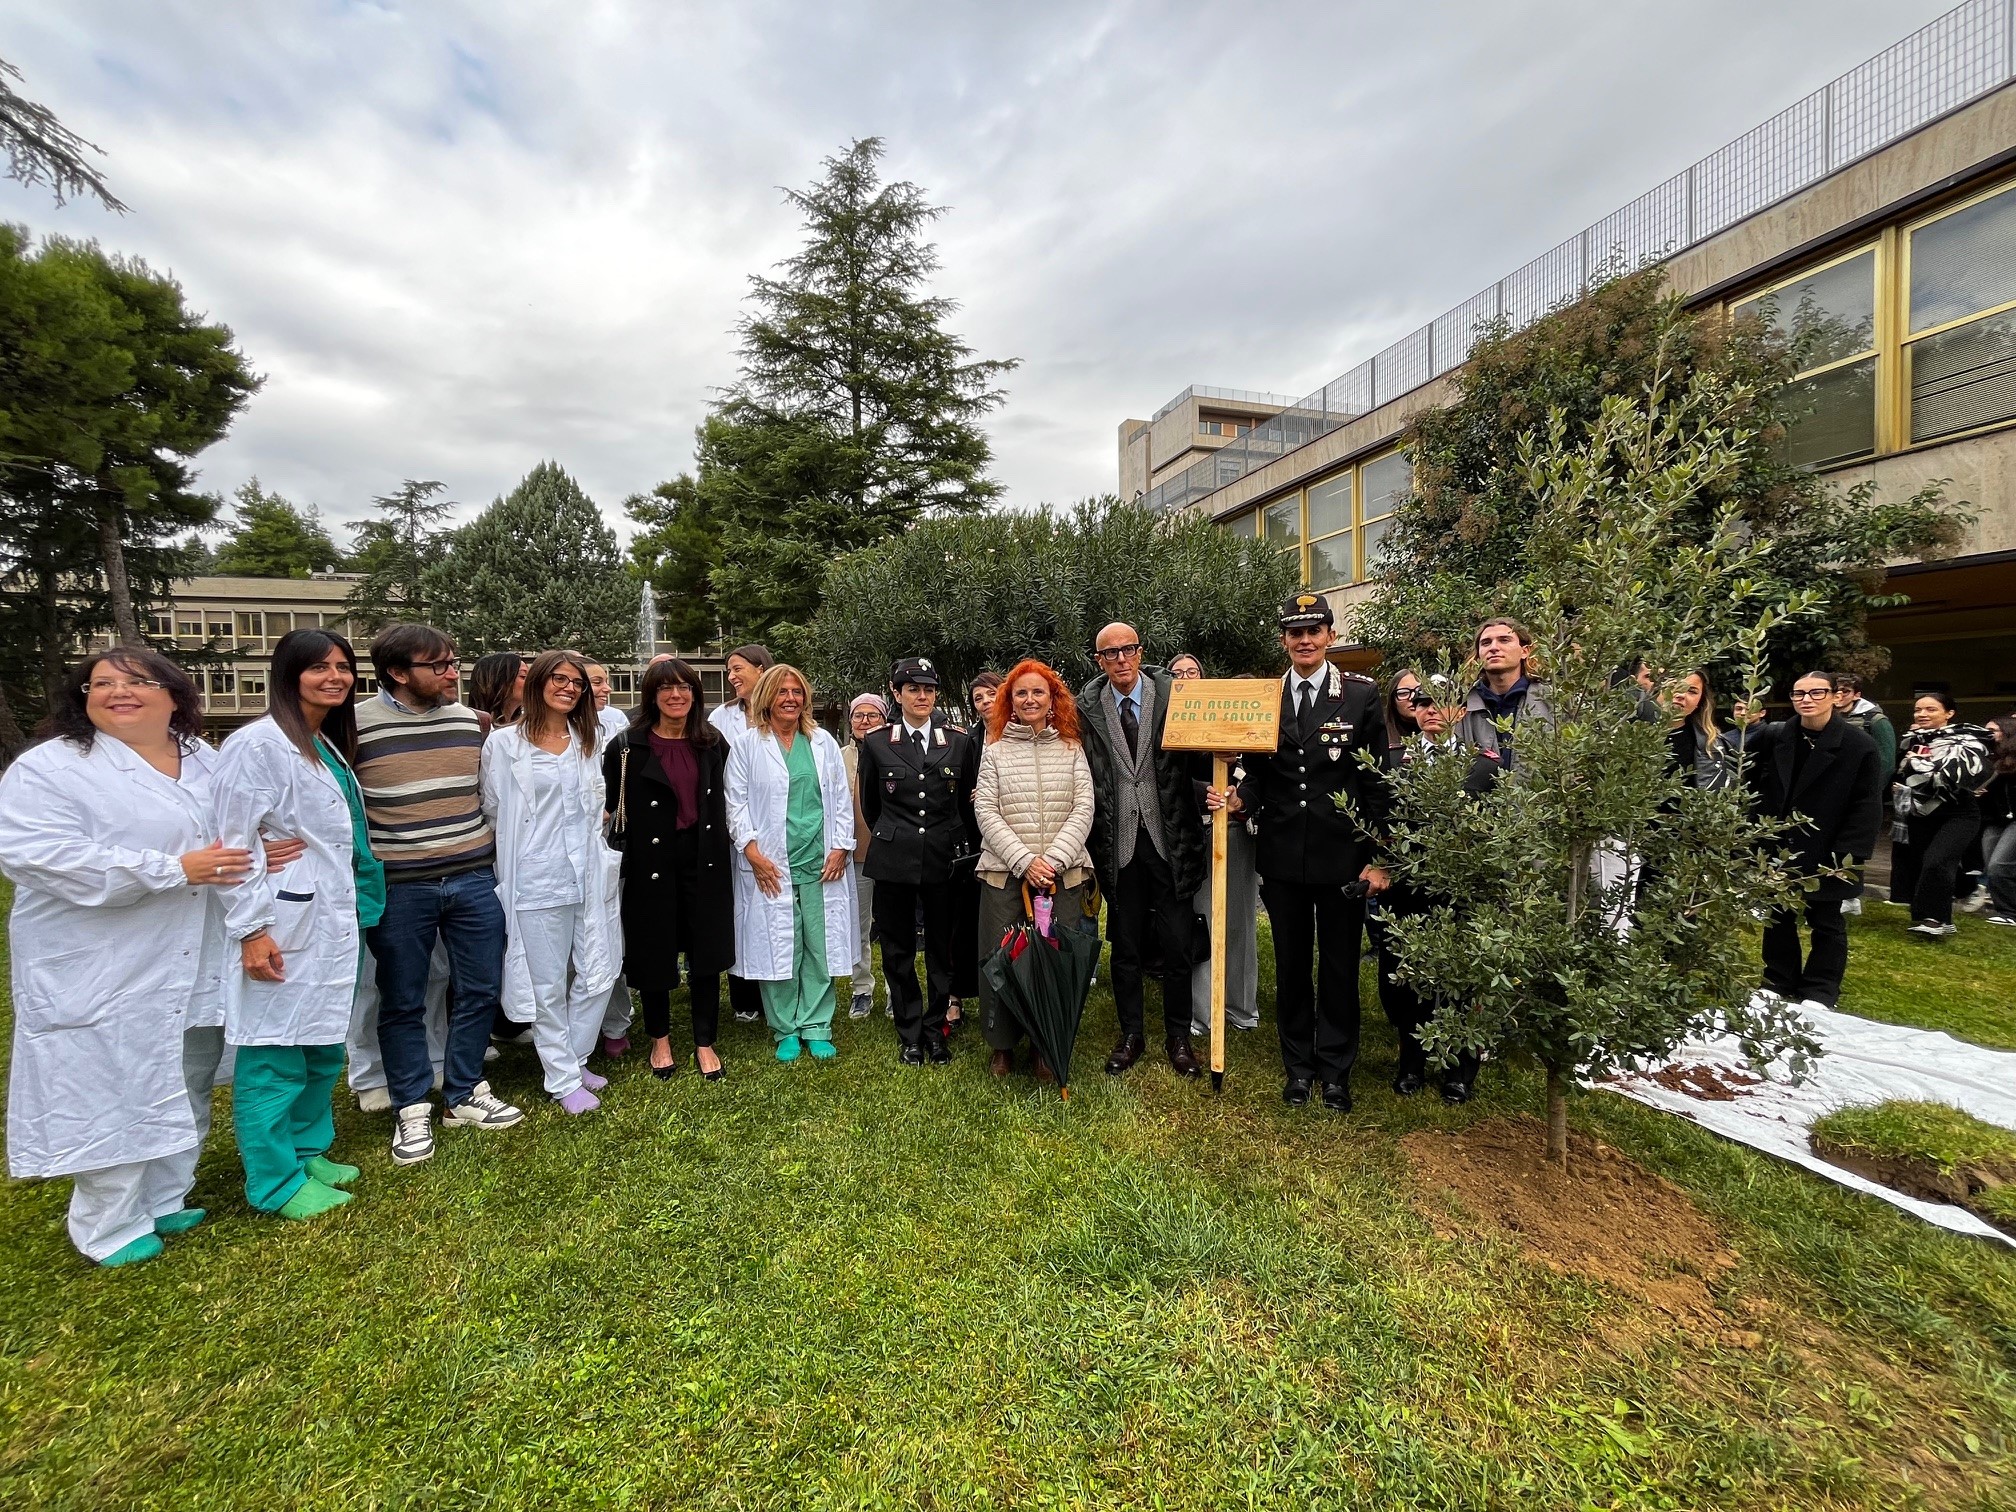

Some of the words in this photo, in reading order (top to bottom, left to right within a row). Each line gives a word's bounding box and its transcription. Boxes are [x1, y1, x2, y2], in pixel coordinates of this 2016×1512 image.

[1184, 700, 1202, 709] UN
[1208, 700, 1261, 709] ALBERO
[1172, 712, 1197, 721] PER
[1202, 712, 1217, 721] LA
[1222, 712, 1272, 721] SALUTE
